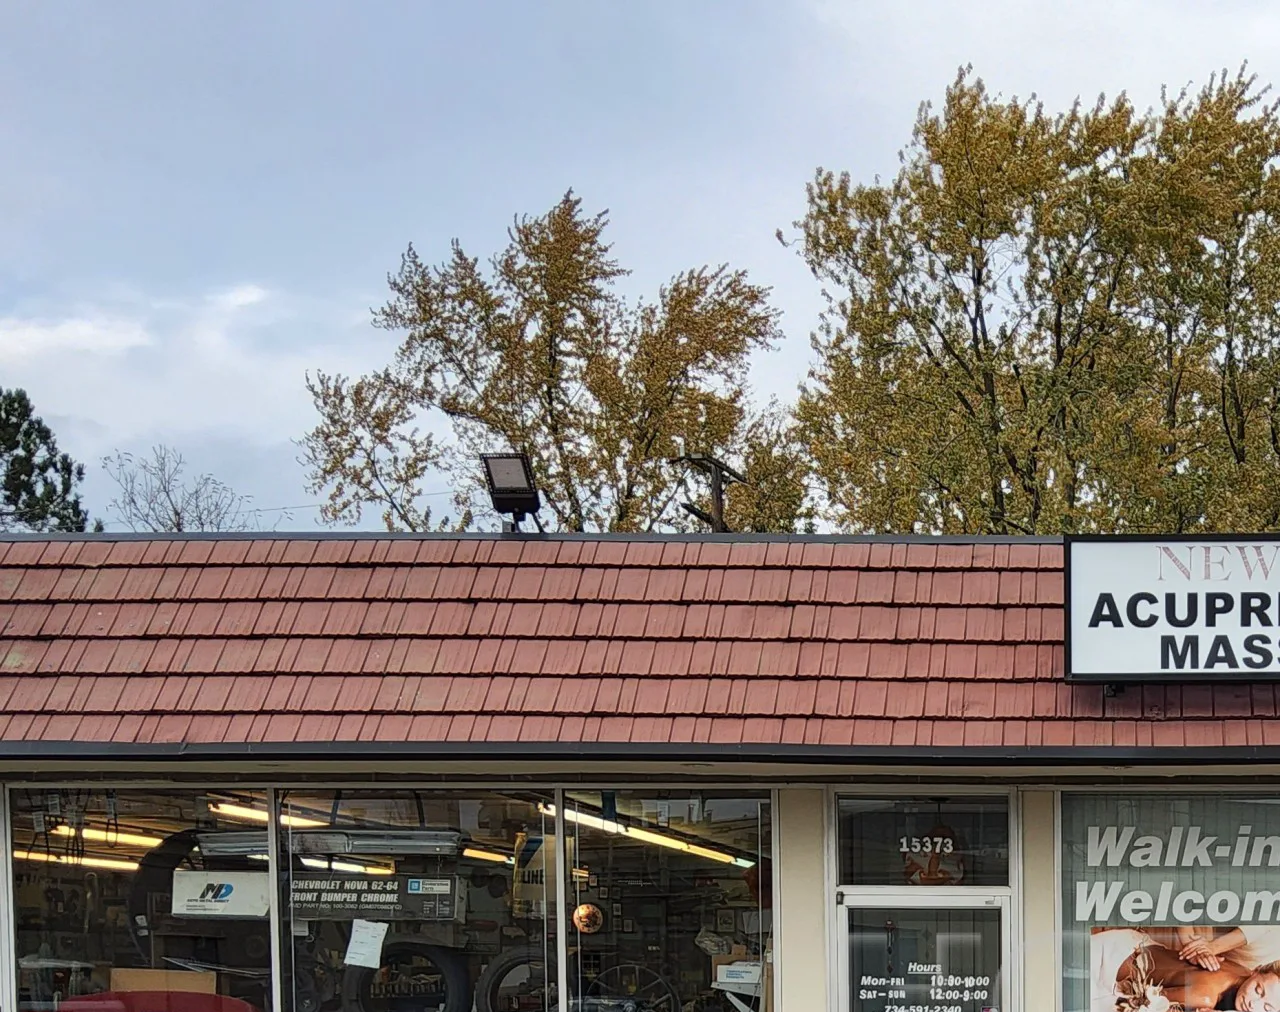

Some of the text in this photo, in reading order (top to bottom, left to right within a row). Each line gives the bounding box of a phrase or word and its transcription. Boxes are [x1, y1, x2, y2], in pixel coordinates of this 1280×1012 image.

[900, 837, 953, 853] 15373
[292, 880, 399, 890] CHEVROLET NOVA 62-64
[290, 892, 398, 903] FRONT BUMPER CHROME
[908, 962, 943, 974] Hours
[929, 988, 988, 1001] 12:00-9:00
